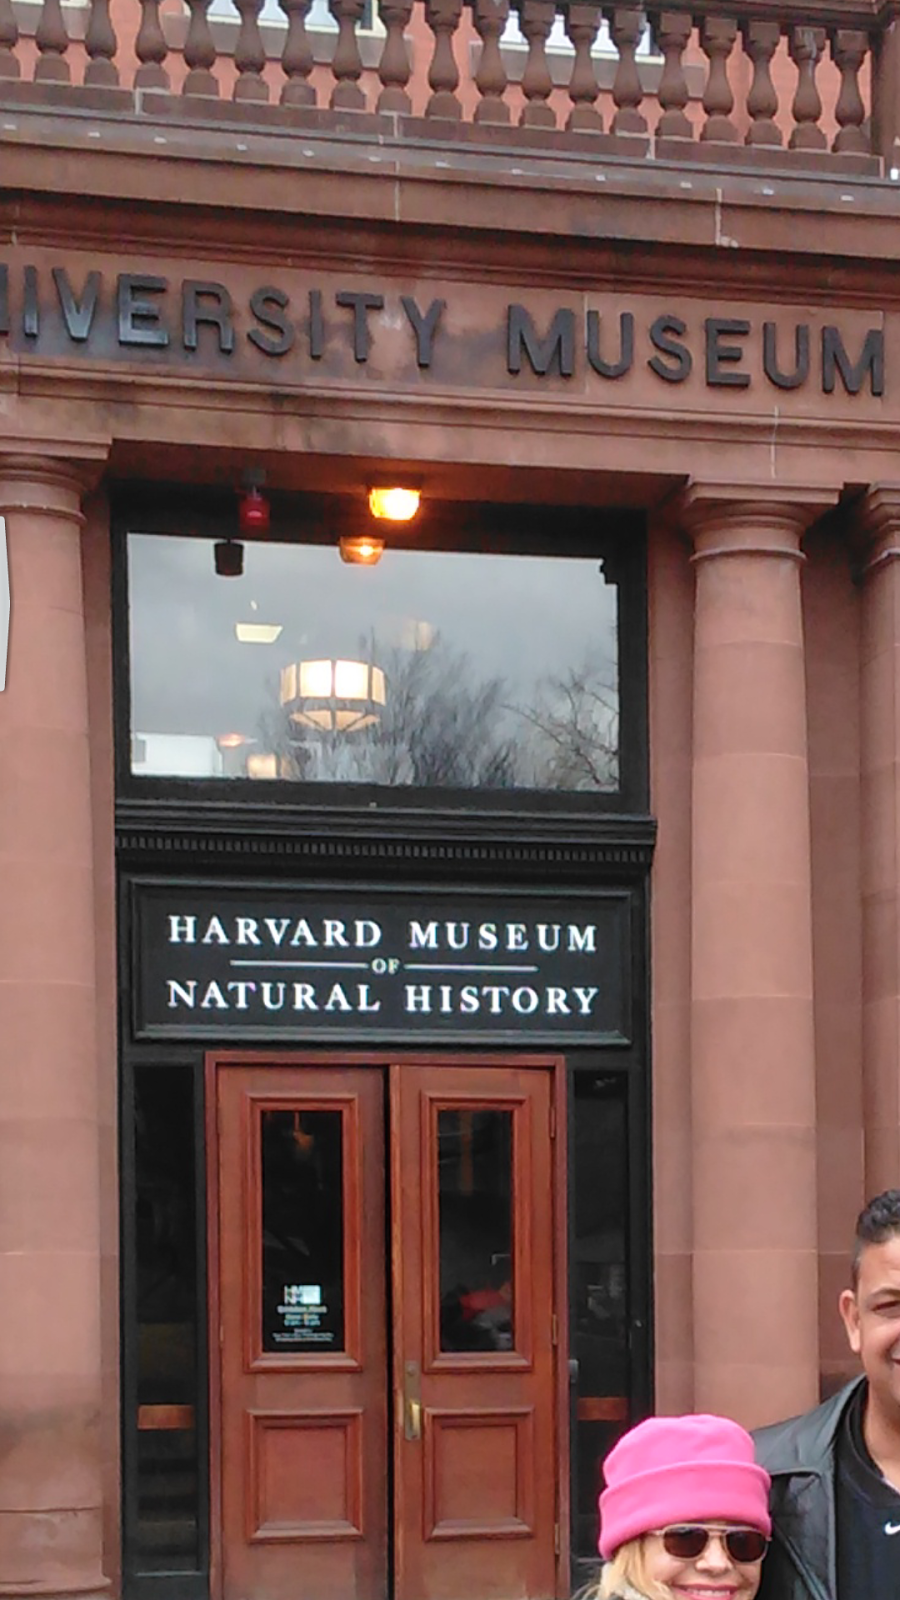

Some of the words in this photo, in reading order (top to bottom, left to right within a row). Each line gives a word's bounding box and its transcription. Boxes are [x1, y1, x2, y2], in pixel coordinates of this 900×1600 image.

[0, 263, 447, 368] IVERSITY
[506, 304, 885, 396] MUSEUM
[168, 915, 383, 948] HARVARD
[409, 921, 598, 952] MUSEUM
[371, 958, 401, 975] OF
[166, 981, 381, 1012] NATURAL
[404, 986, 600, 1016] HISTORY
